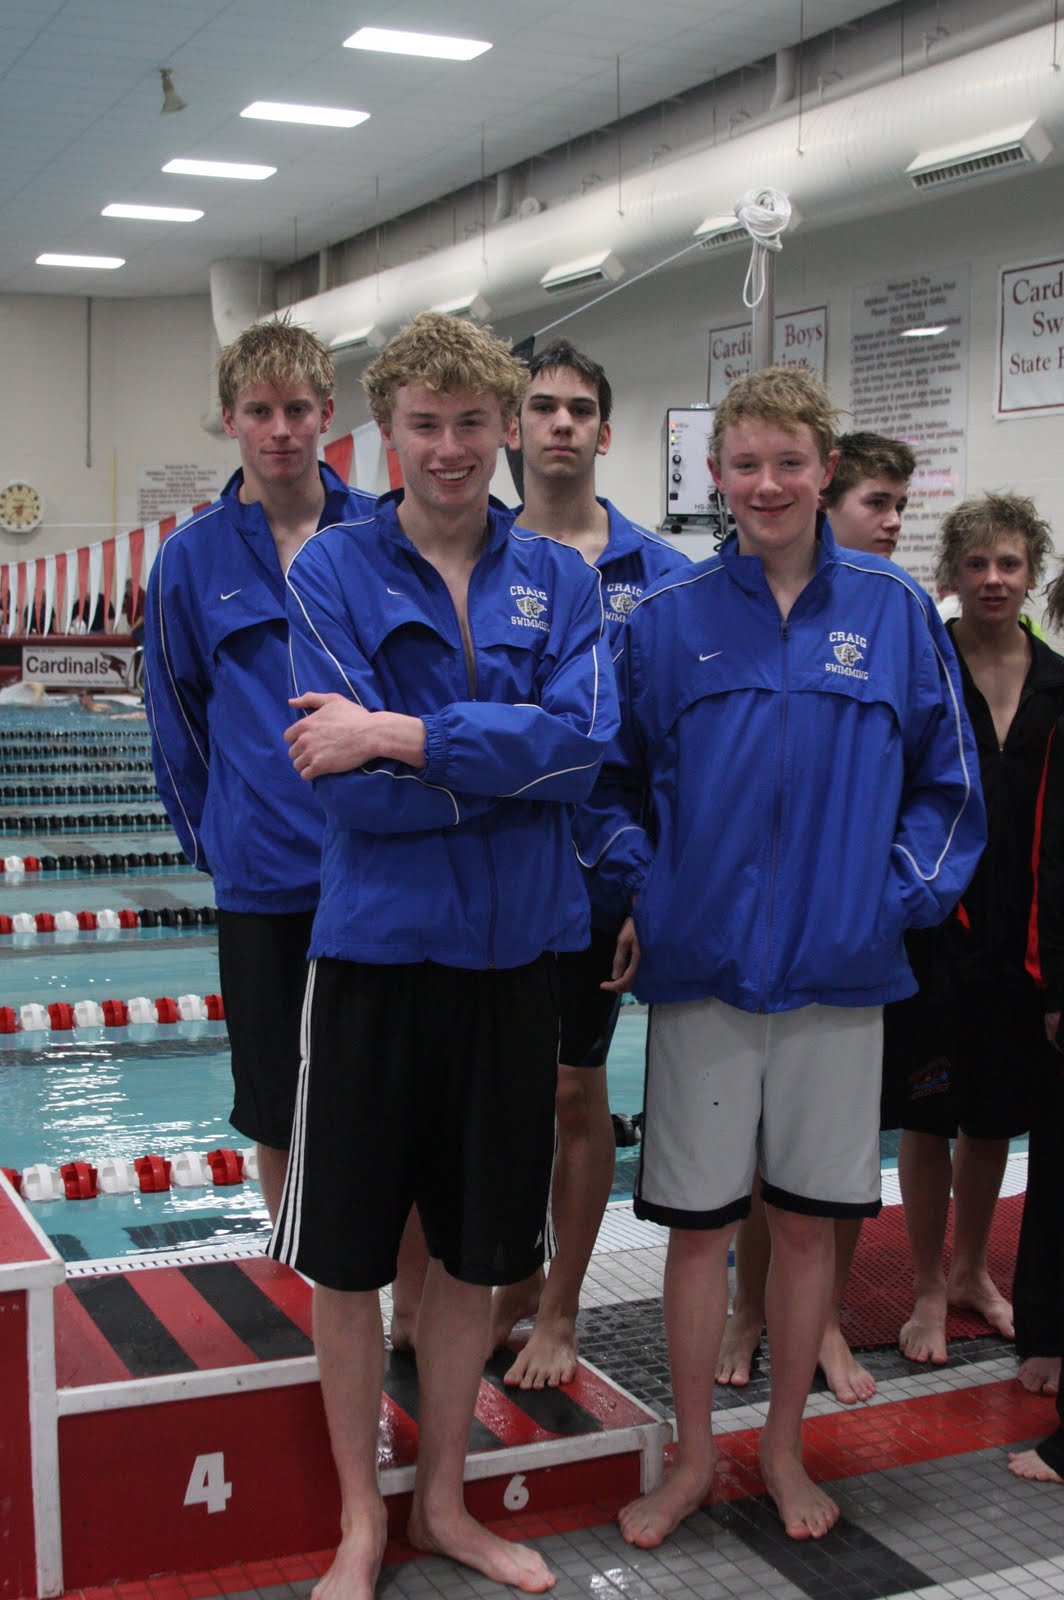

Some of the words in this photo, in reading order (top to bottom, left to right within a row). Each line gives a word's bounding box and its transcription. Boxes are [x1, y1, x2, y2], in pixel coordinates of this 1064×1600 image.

[712, 331, 752, 360] Cardi
[785, 323, 823, 349] Boys
[1009, 353, 1051, 376] State
[510, 586, 548, 601] CRAIG
[829, 631, 867, 649] CRAIG
[26, 655, 109, 675] Cardinals
[825, 662, 869, 681] SWIMMING
[183, 1451, 232, 1514] 4
[503, 1473, 530, 1511] 6
